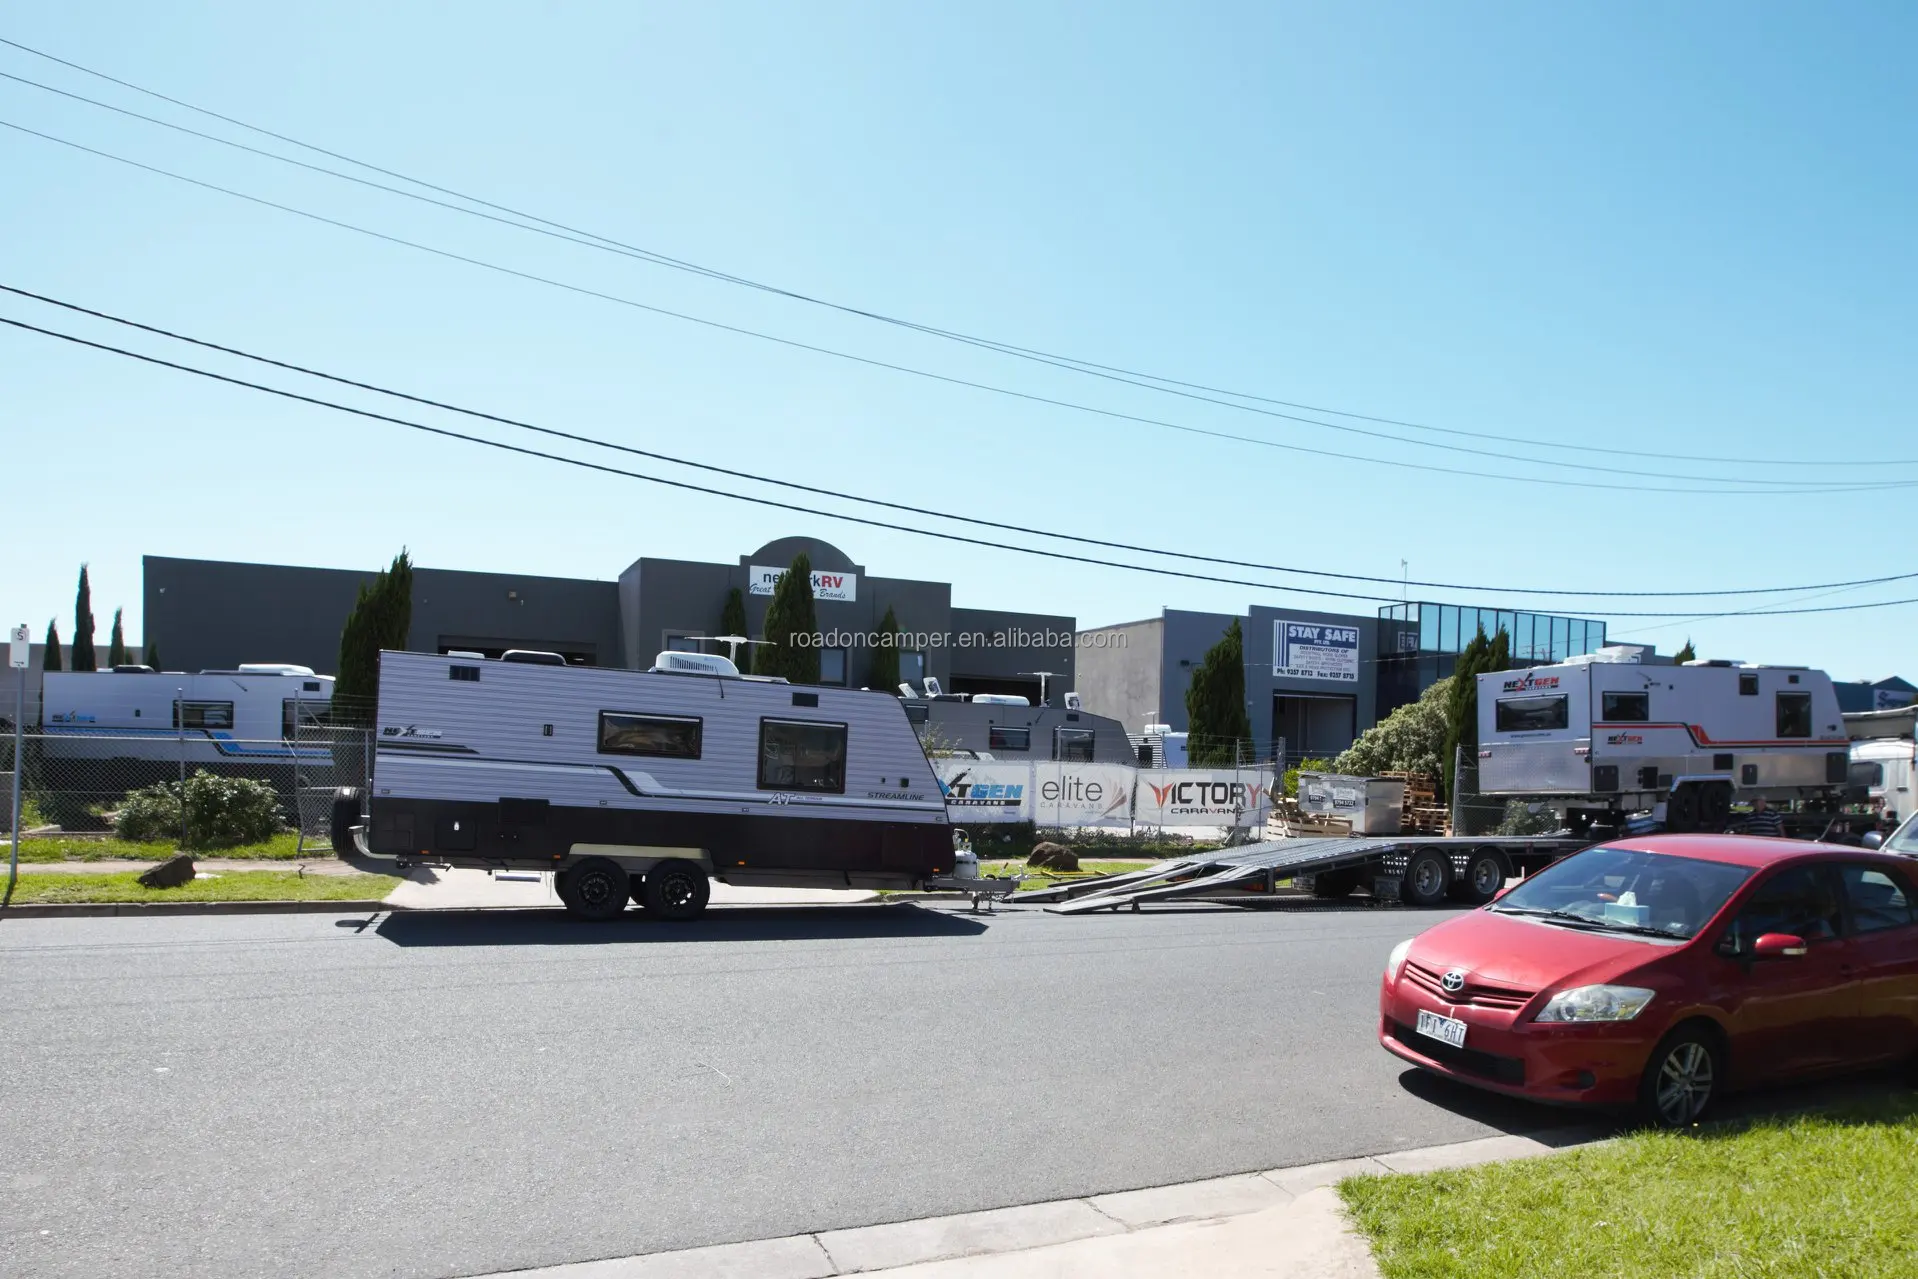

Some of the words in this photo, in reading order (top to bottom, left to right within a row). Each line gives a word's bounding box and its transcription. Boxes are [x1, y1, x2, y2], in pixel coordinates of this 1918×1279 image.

[820, 589, 846, 599] Brands
[1289, 626, 1320, 638] STAY
[1325, 629, 1356, 642] SAFE
[1504, 673, 1559, 691] NEXTGEN
[1042, 776, 1102, 801] elite
[1149, 782, 1262, 808] VICTORY
[768, 792, 794, 805] AT
[868, 792, 924, 800] STREAMLINE
[1040, 802, 1102, 810] CARAVANS
